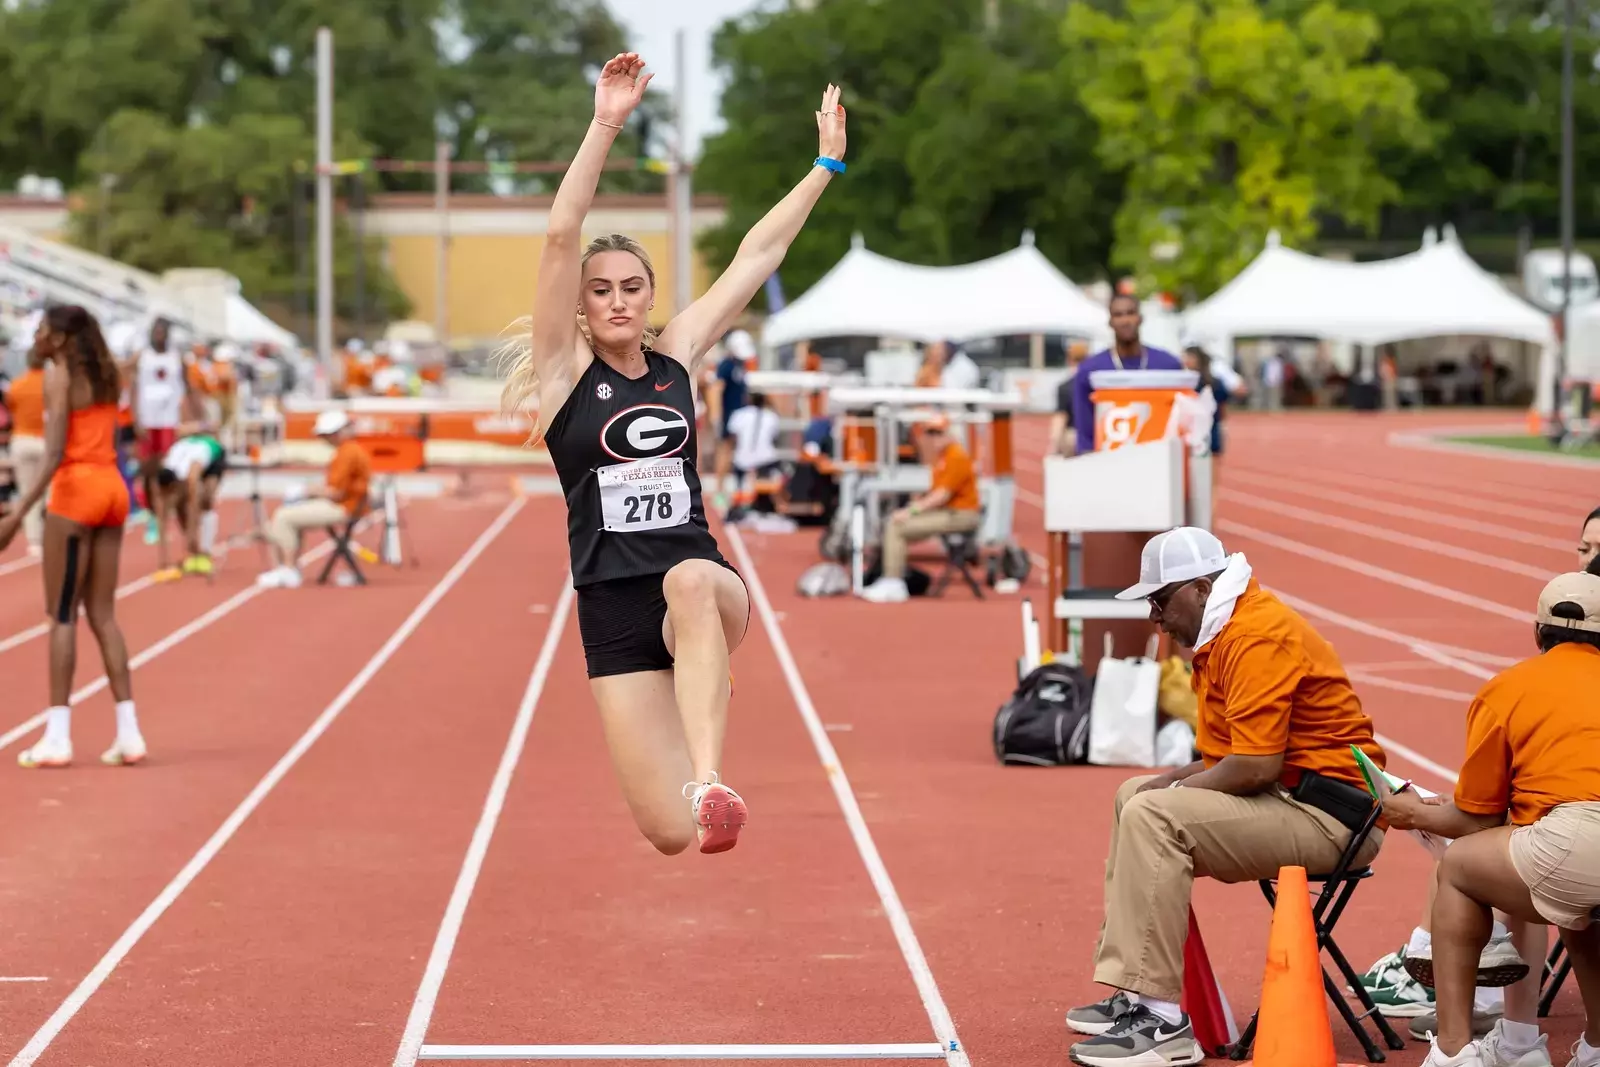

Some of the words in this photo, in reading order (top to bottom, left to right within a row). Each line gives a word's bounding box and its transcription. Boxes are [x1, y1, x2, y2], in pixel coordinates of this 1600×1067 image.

[597, 383, 613, 399] SEC
[621, 471, 653, 481] TEXAS
[653, 470, 682, 478] RELAYS
[638, 483, 662, 491] TRUIST
[623, 492, 673, 524] 278
